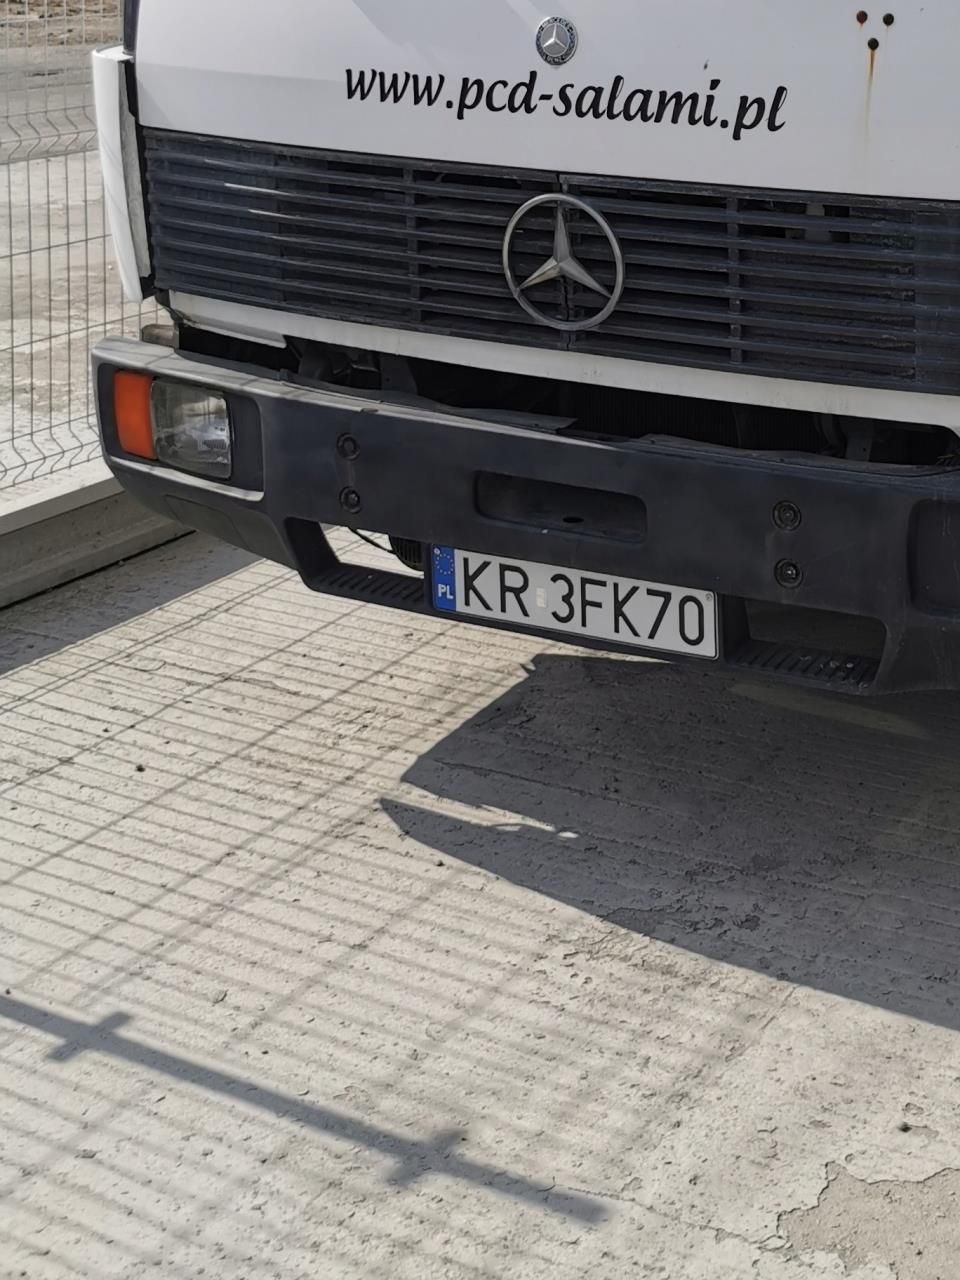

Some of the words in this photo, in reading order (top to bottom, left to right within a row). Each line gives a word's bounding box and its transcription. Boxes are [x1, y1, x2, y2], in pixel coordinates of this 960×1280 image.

[345, 68, 789, 141] www.pcd-salami.pl
[437, 584, 454, 600] PL
[462, 556, 530, 618] KR
[550, 573, 705, 647] 3FK70
